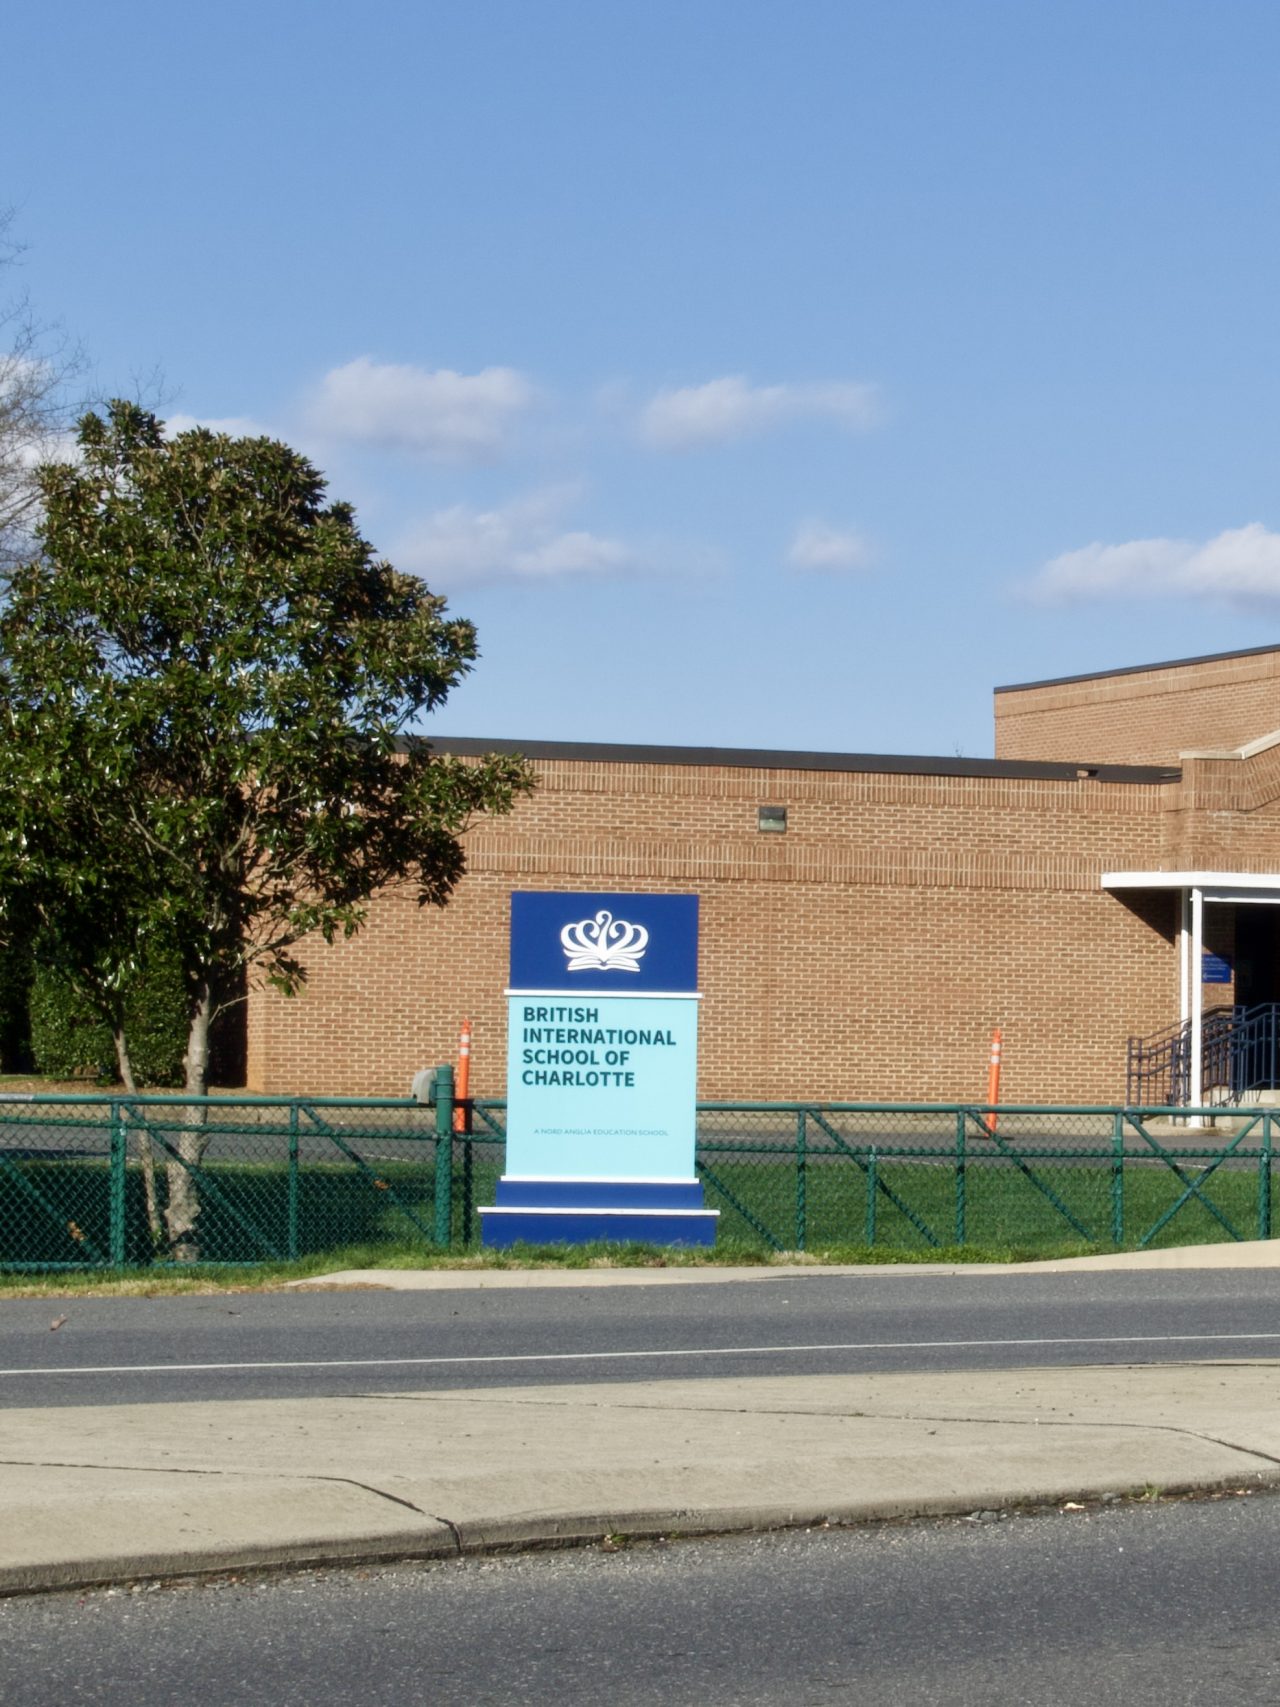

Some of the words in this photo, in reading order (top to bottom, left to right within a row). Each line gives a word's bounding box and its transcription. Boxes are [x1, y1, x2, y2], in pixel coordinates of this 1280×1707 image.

[523, 1006, 599, 1023] BRITISH
[523, 1027, 677, 1046] INTERNATIONAL
[522, 1048, 600, 1066] SCHOOL
[604, 1050, 630, 1066] OF
[521, 1069, 635, 1087] CHARLOTTE
[639, 1129, 669, 1137] SCHOOL
